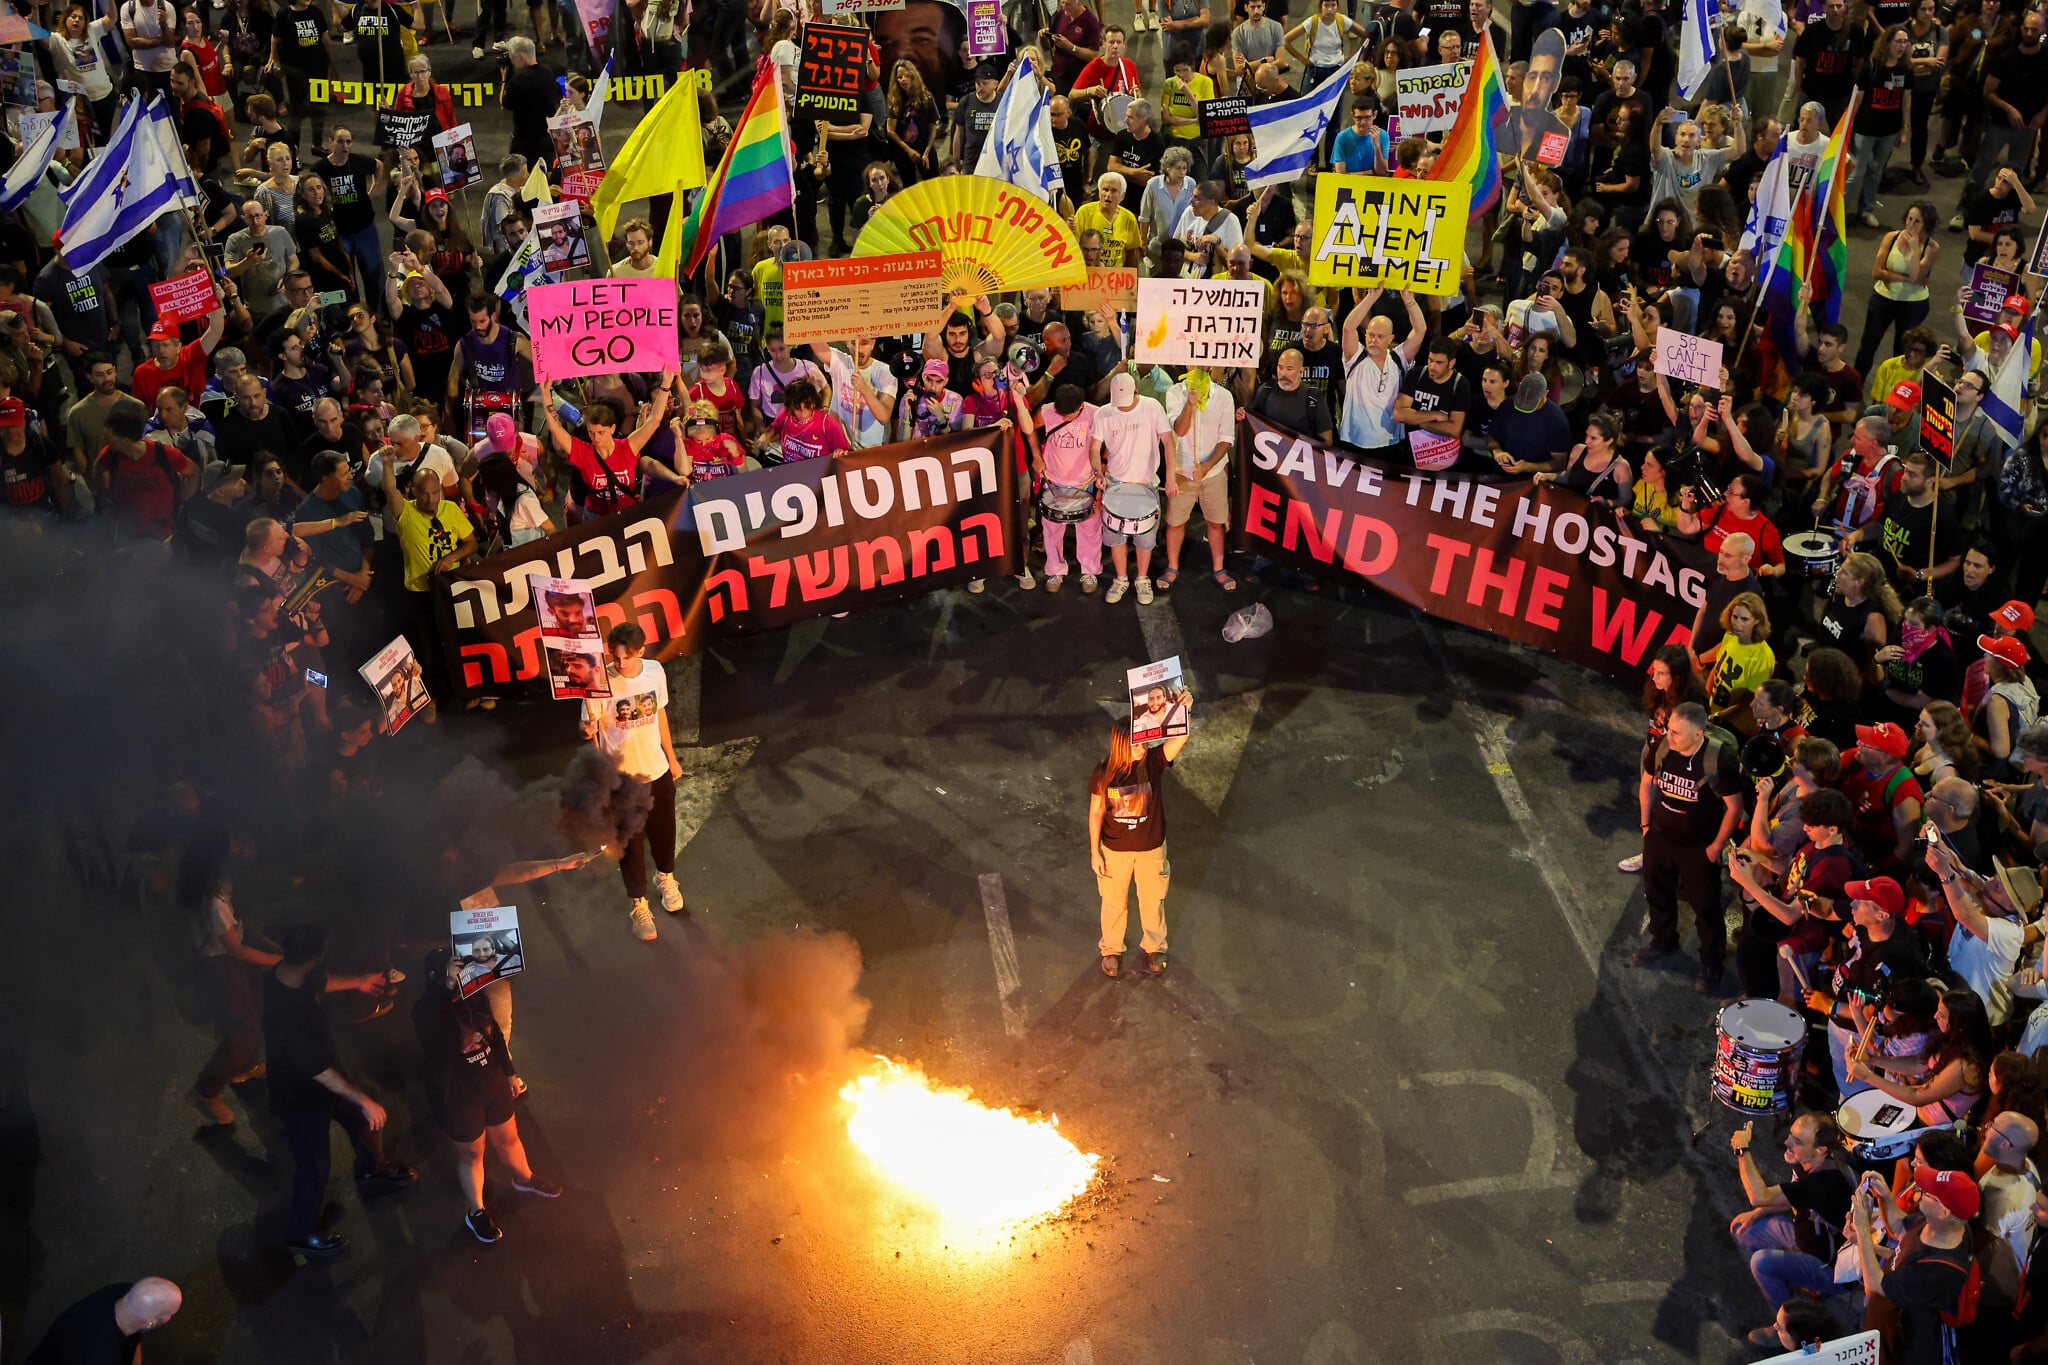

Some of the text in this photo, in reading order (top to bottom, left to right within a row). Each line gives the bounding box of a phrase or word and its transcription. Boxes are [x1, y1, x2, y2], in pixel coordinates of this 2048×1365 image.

[807, 34, 863, 63] ביבי
[804, 61, 859, 89] בוגד
[1398, 63, 1465, 94] להפקרה
[308, 79, 404, 110] קופים
[1206, 100, 1246, 110] החטופים
[1207, 118, 1247, 127] הממשלה
[1218, 107, 1246, 116] הביתה
[1208, 127, 1236, 136] הביתה
[908, 211, 993, 251] בוערת
[995, 191, 1073, 268] אדמתי
[1314, 202, 1449, 271] ALL
[1334, 222, 1428, 252] THEM
[787, 258, 937, 282] בית בעזה הכי זול בארץ!
[66, 275, 91, 291] למה הם
[155, 273, 207, 294] END THE WAR
[172, 286, 199, 299] BRING
[571, 283, 637, 306] LET
[163, 290, 212, 312] ALL OF THEM
[1172, 287, 1259, 307] הממשלה
[178, 303, 203, 316] HOME
[540, 307, 673, 337] MY PEOPLE
[1184, 315, 1256, 333] הורגת
[571, 335, 635, 366] GO
[1189, 341, 1253, 359] אותנו
[1679, 335, 1698, 351] 58
[1666, 346, 1711, 369] CAN'T
[1667, 362, 1707, 383] WAIT
[798, 444, 816, 458] FRONT
[1252, 431, 1385, 498] SAVE
[1404, 475, 1501, 528] THE
[451, 447, 998, 629] החטופים הביתה
[703, 511, 1006, 624] הממשלה
[1245, 483, 1399, 576] END
[1426, 533, 1570, 632] THE
[1657, 778, 1698, 800] בחטופים
[1662, 771, 1695, 789] בוחרים
[1835, 1338, 1876, 1362] אנחנו
